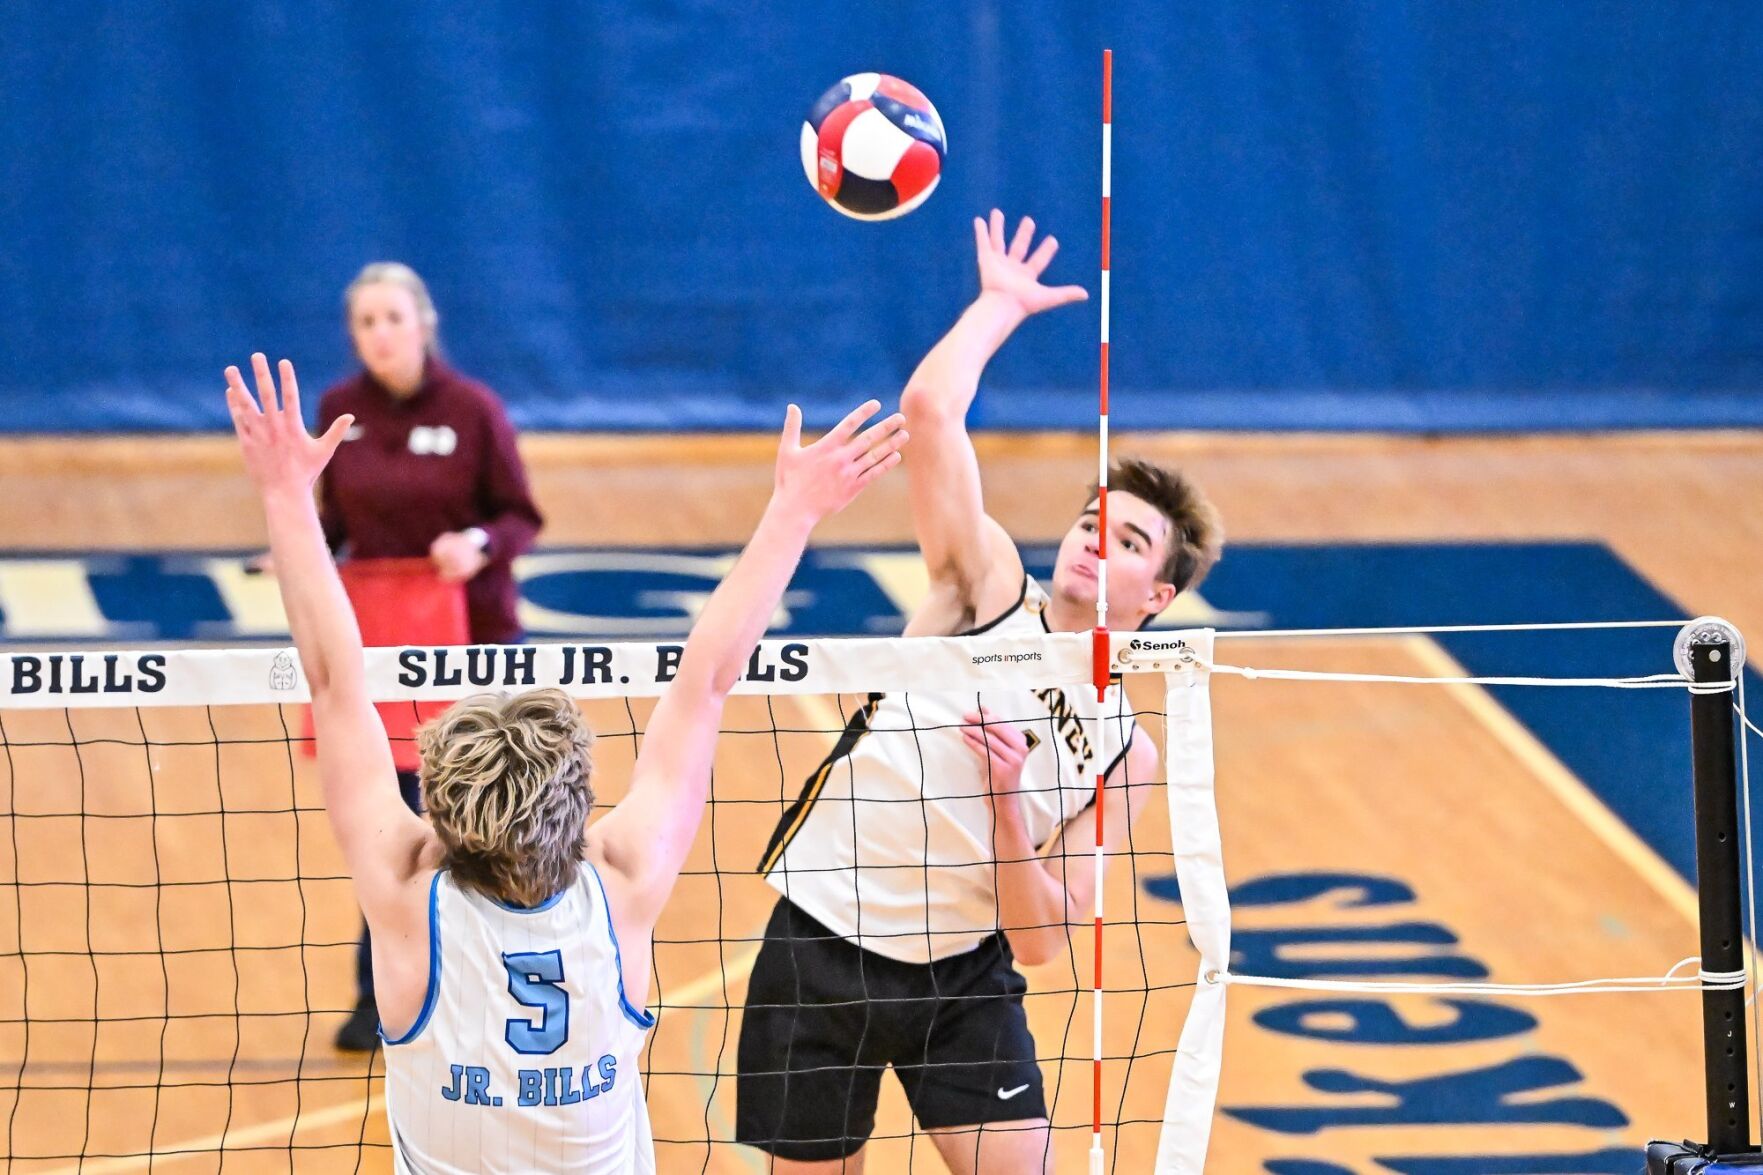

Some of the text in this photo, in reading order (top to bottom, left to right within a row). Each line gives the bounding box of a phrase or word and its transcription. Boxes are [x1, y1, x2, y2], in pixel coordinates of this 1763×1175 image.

[399, 643, 809, 688] SLUH JR. BLS
[972, 652, 1042, 665] sports imports
[1142, 640, 1186, 650] Senoh
[11, 655, 167, 694] BILLS
[501, 949, 569, 1055] 5
[441, 1054, 617, 1107] JR. BILLS
